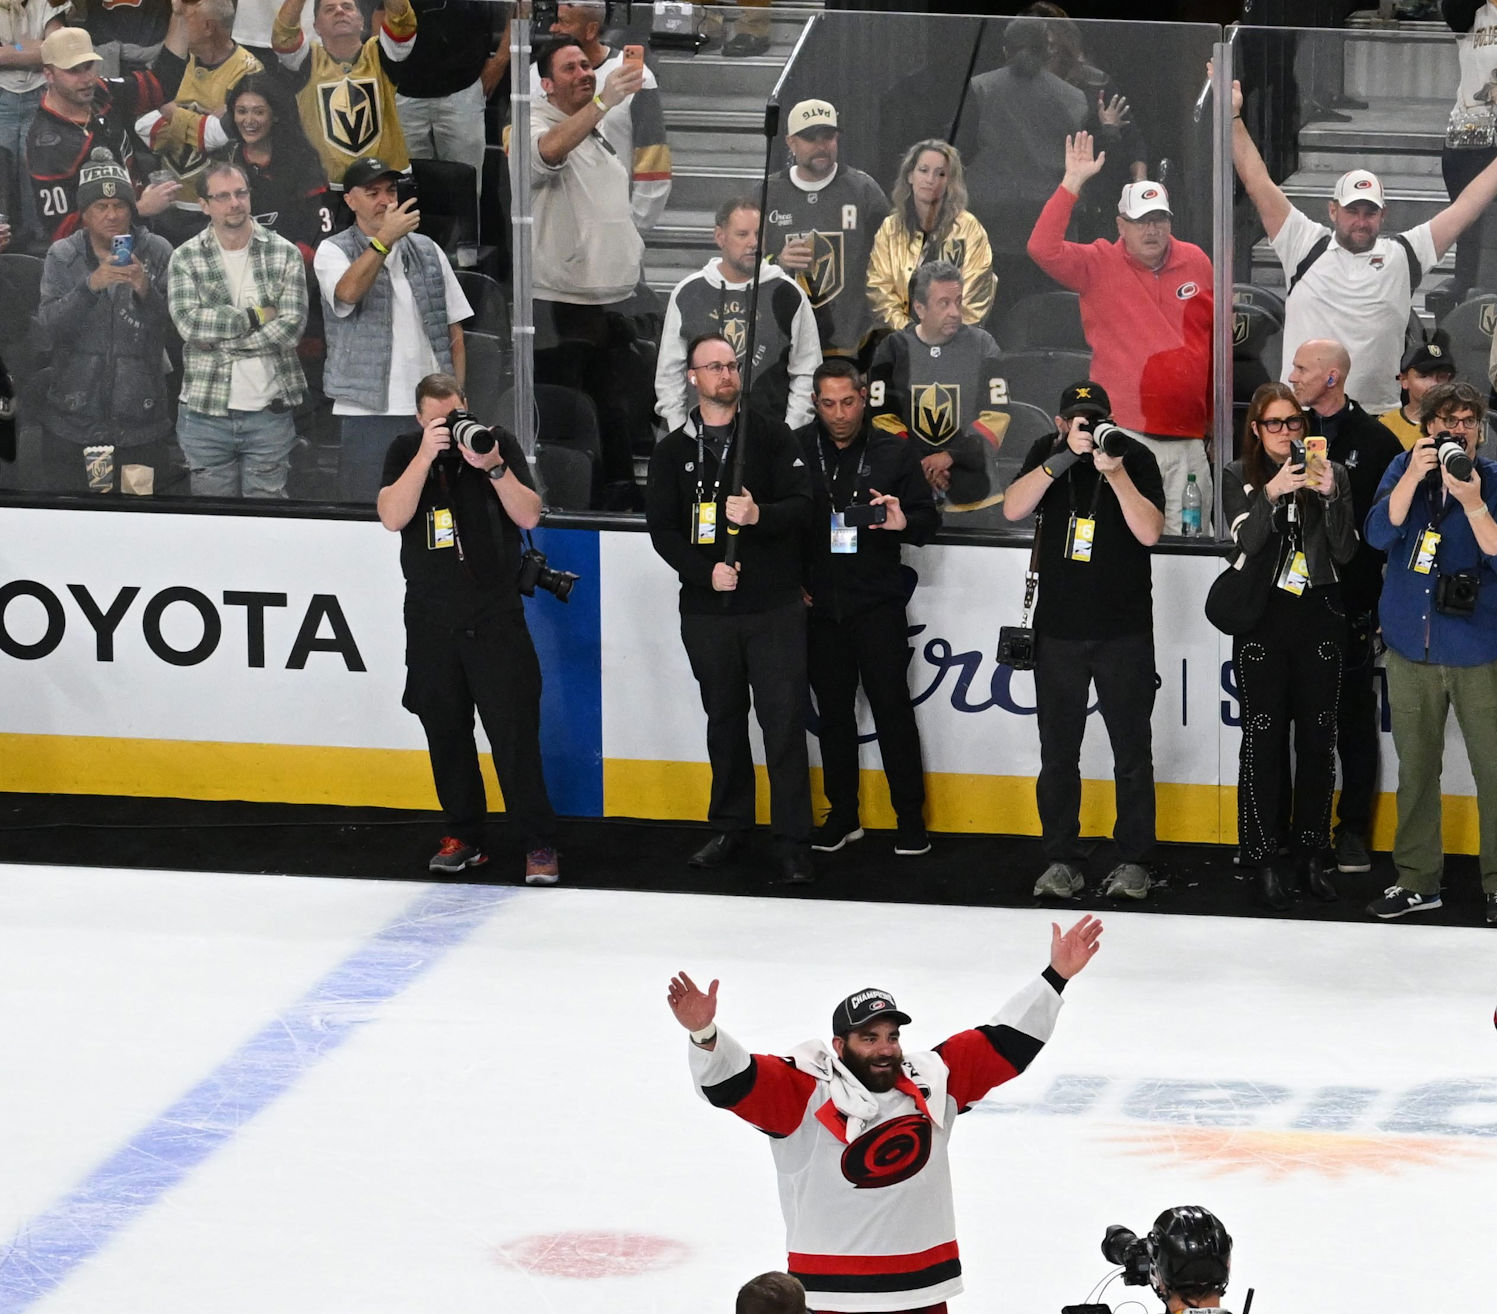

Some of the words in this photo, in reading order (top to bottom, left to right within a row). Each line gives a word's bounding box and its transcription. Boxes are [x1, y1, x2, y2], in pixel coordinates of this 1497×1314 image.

[40, 186, 69, 216] 20
[319, 207, 333, 232] 3
[842, 205, 856, 230] A
[869, 379, 886, 408] 9
[988, 377, 1008, 405] 2
[0, 579, 367, 672] OYOTA
